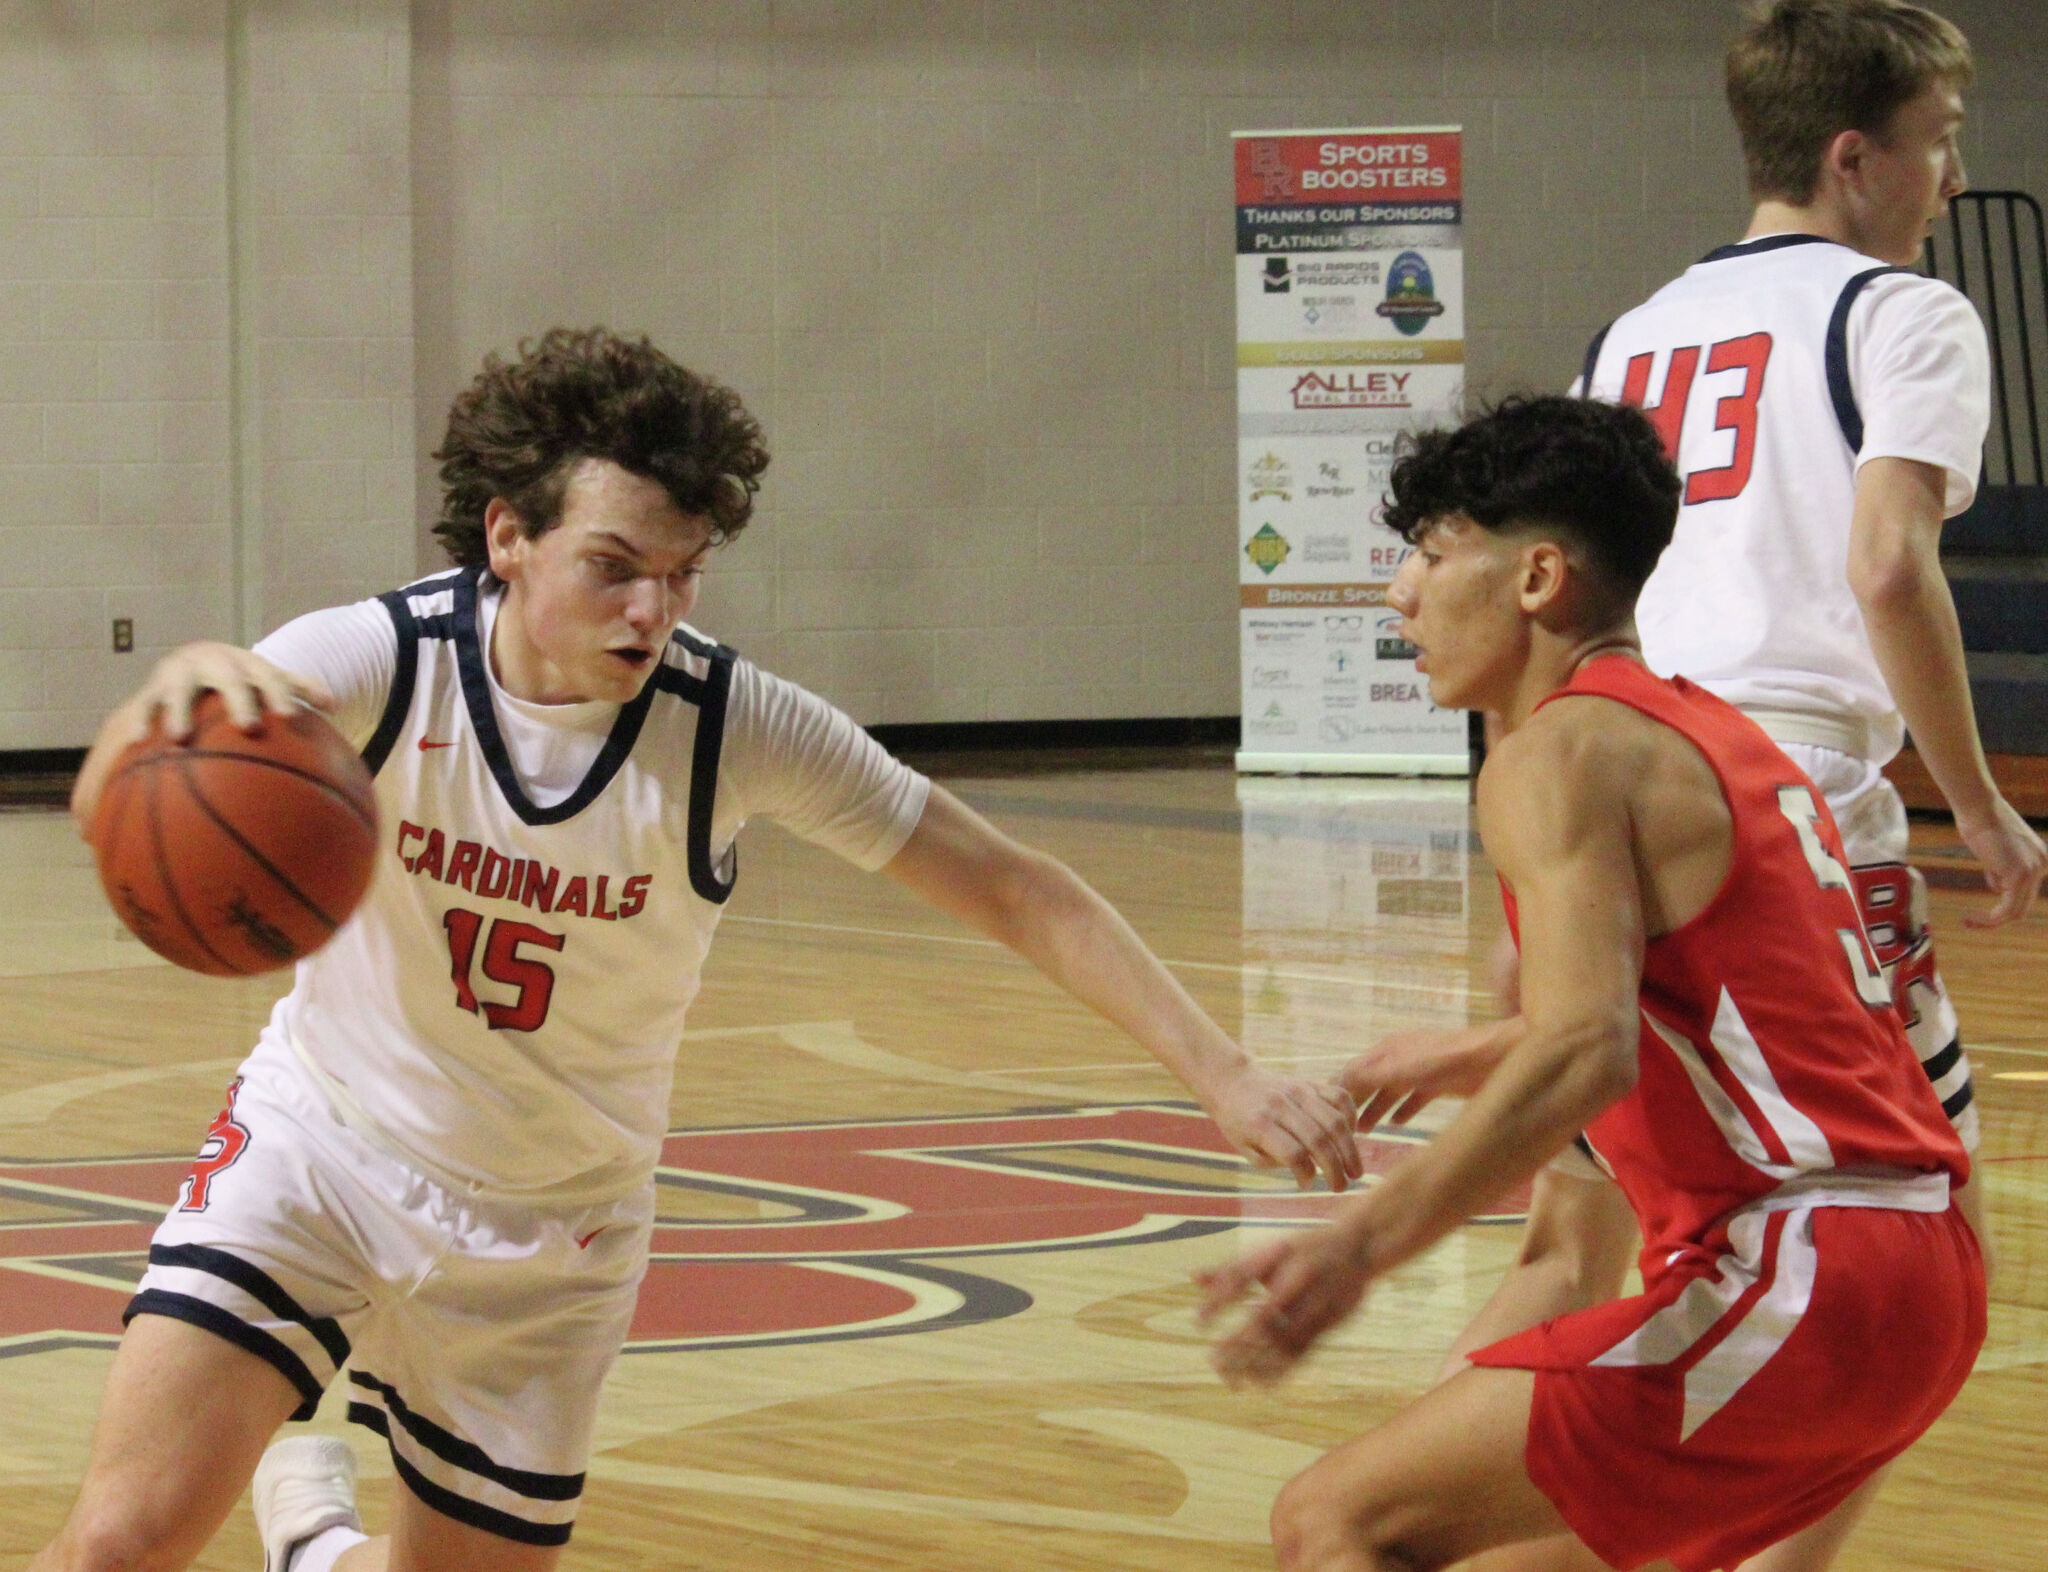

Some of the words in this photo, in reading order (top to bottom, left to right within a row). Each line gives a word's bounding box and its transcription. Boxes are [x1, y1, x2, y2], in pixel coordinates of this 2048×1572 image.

[1319, 142, 1429, 165] SPORTS
[1301, 167, 1447, 190] BOOSTERS
[1244, 208, 1316, 224] THANKS
[1319, 209, 1356, 222] OUR
[1360, 206, 1455, 222] SPONSORS
[1255, 233, 1343, 249] PLATINUM
[1296, 262, 1321, 273] BIG
[1324, 261, 1380, 272] RAPIDS
[1296, 275, 1380, 286] PRODUCTS
[1620, 331, 1773, 506] 43
[1267, 588, 1339, 605] BRONZE
[397, 819, 653, 921] CARDINALS
[443, 907, 566, 1033] 15
